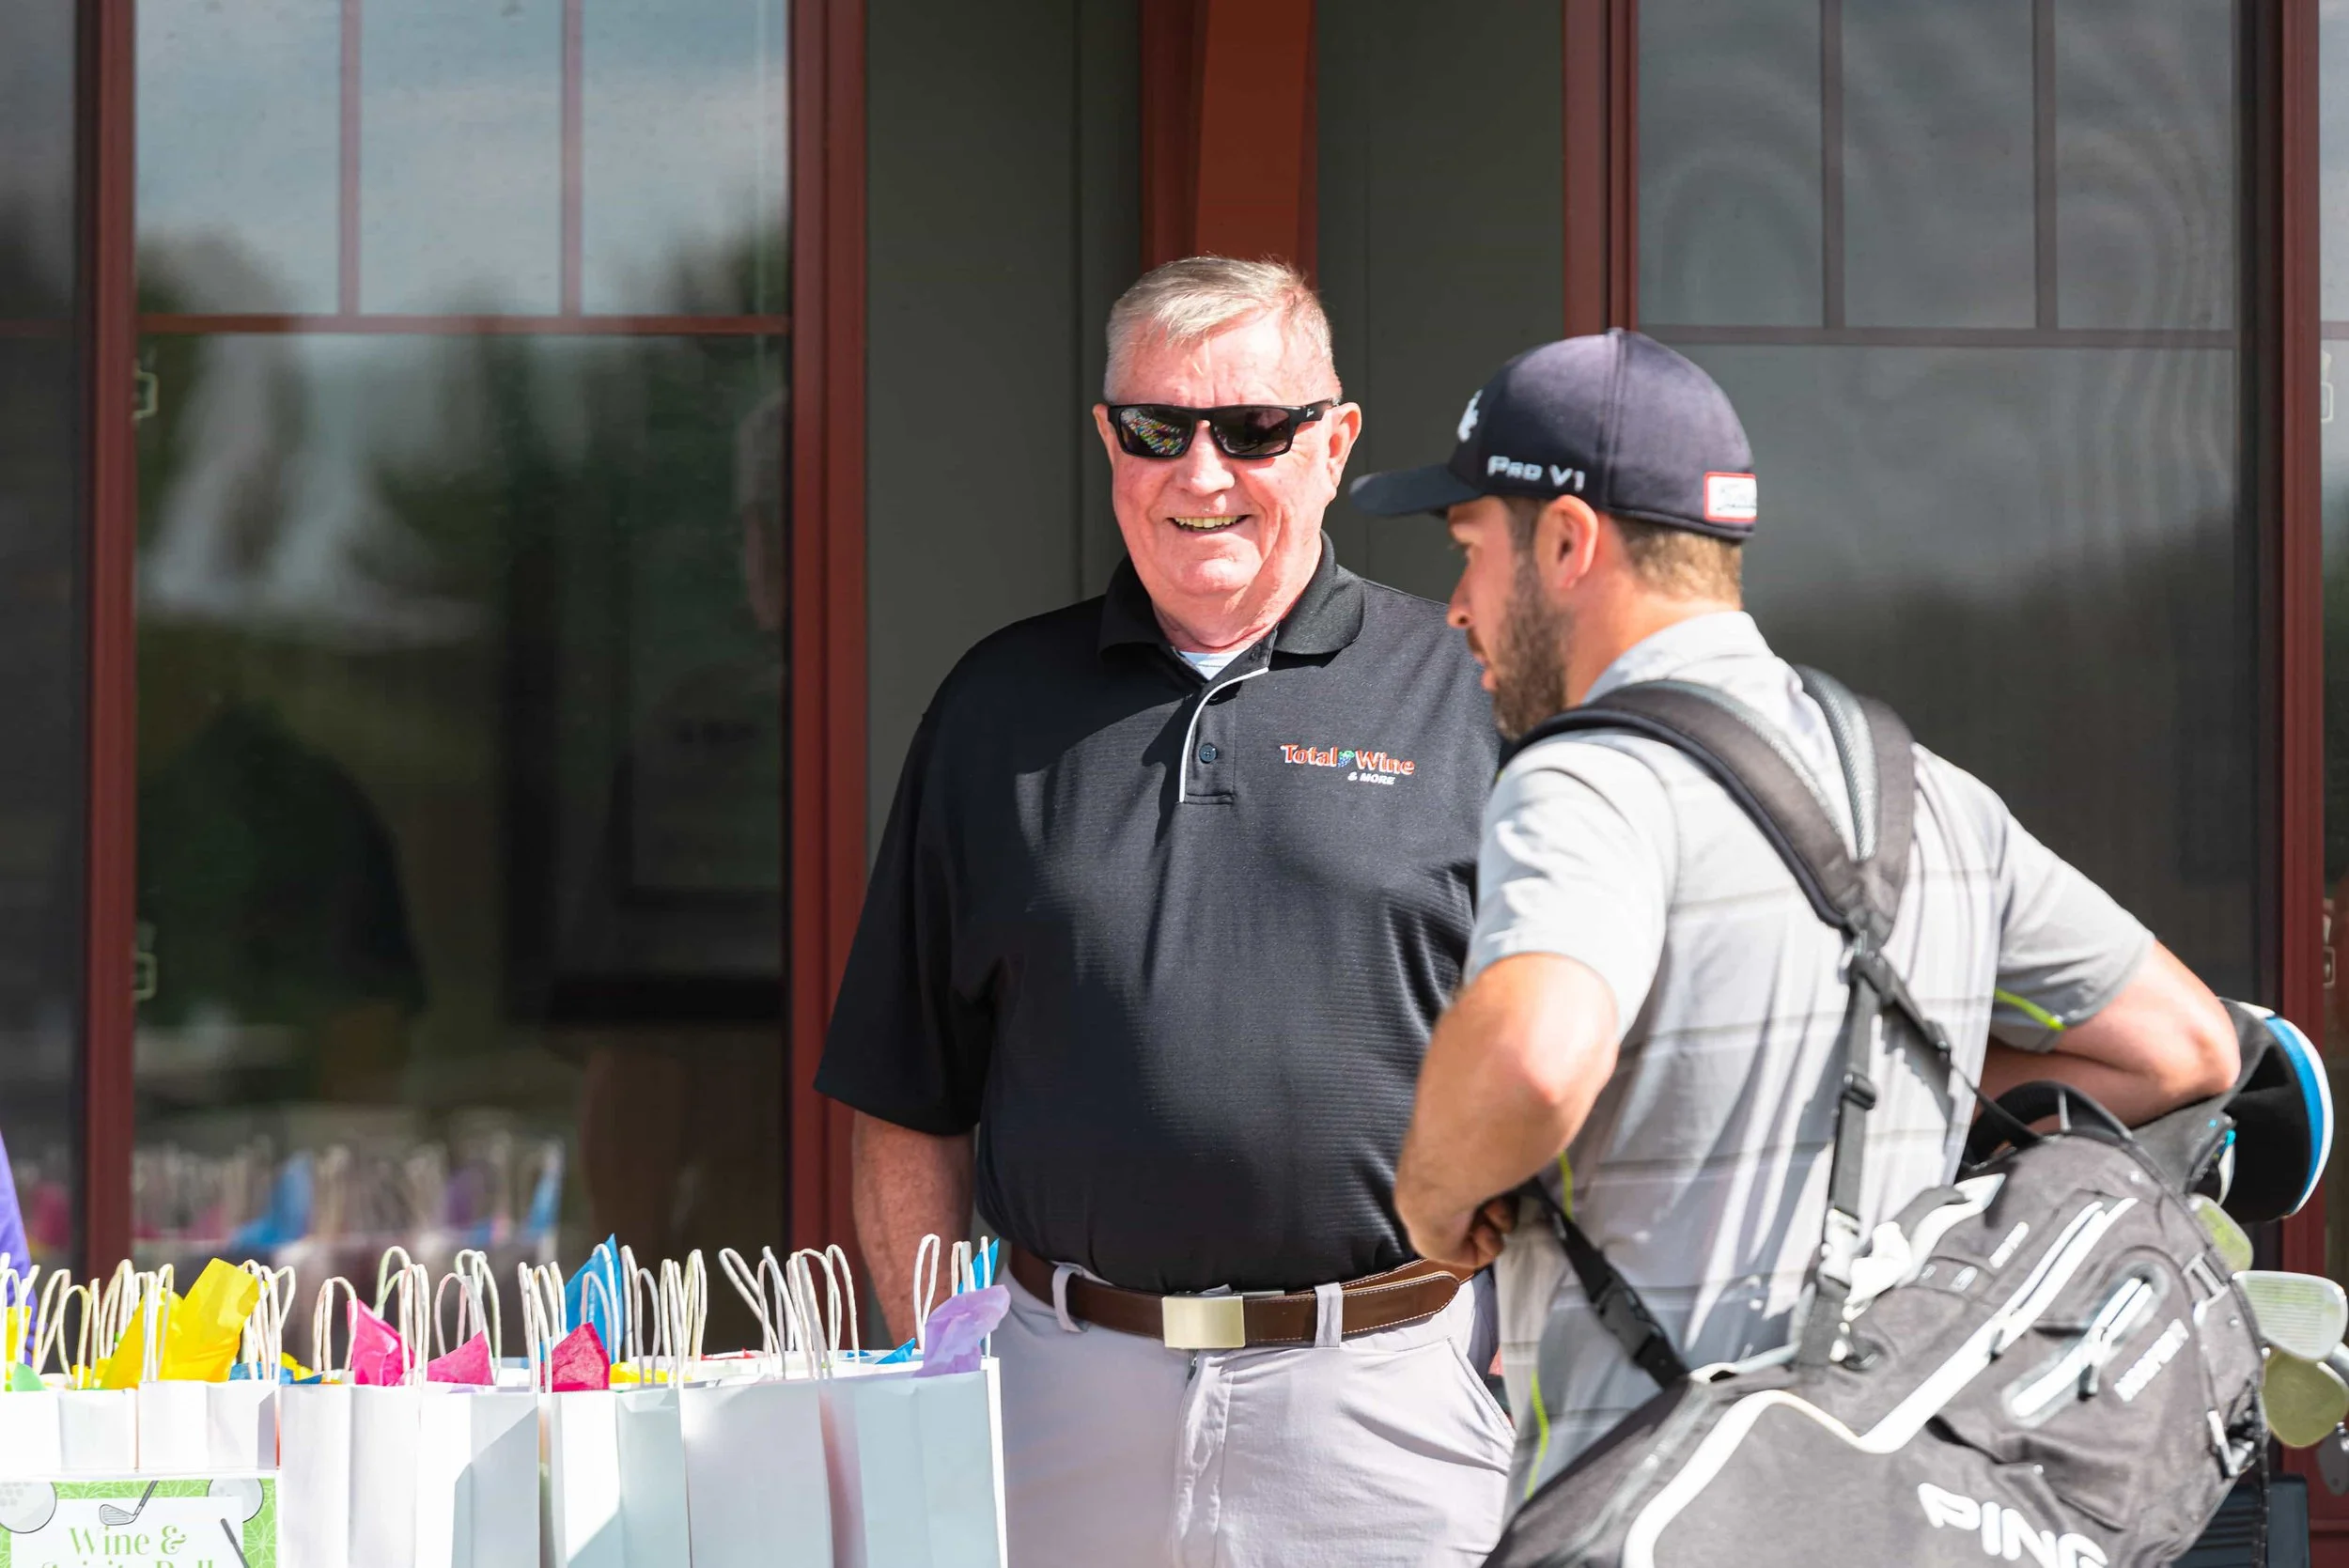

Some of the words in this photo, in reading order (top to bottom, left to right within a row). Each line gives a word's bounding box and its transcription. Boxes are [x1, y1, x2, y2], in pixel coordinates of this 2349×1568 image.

[1549, 464, 1585, 492] V1
[1280, 744, 1338, 768] Total
[1355, 750, 1415, 775] Wine
[1347, 771, 1358, 782] &
[1360, 772, 1395, 785] MORE
[68, 1525, 149, 1556] Wine
[160, 1524, 187, 1556] &
